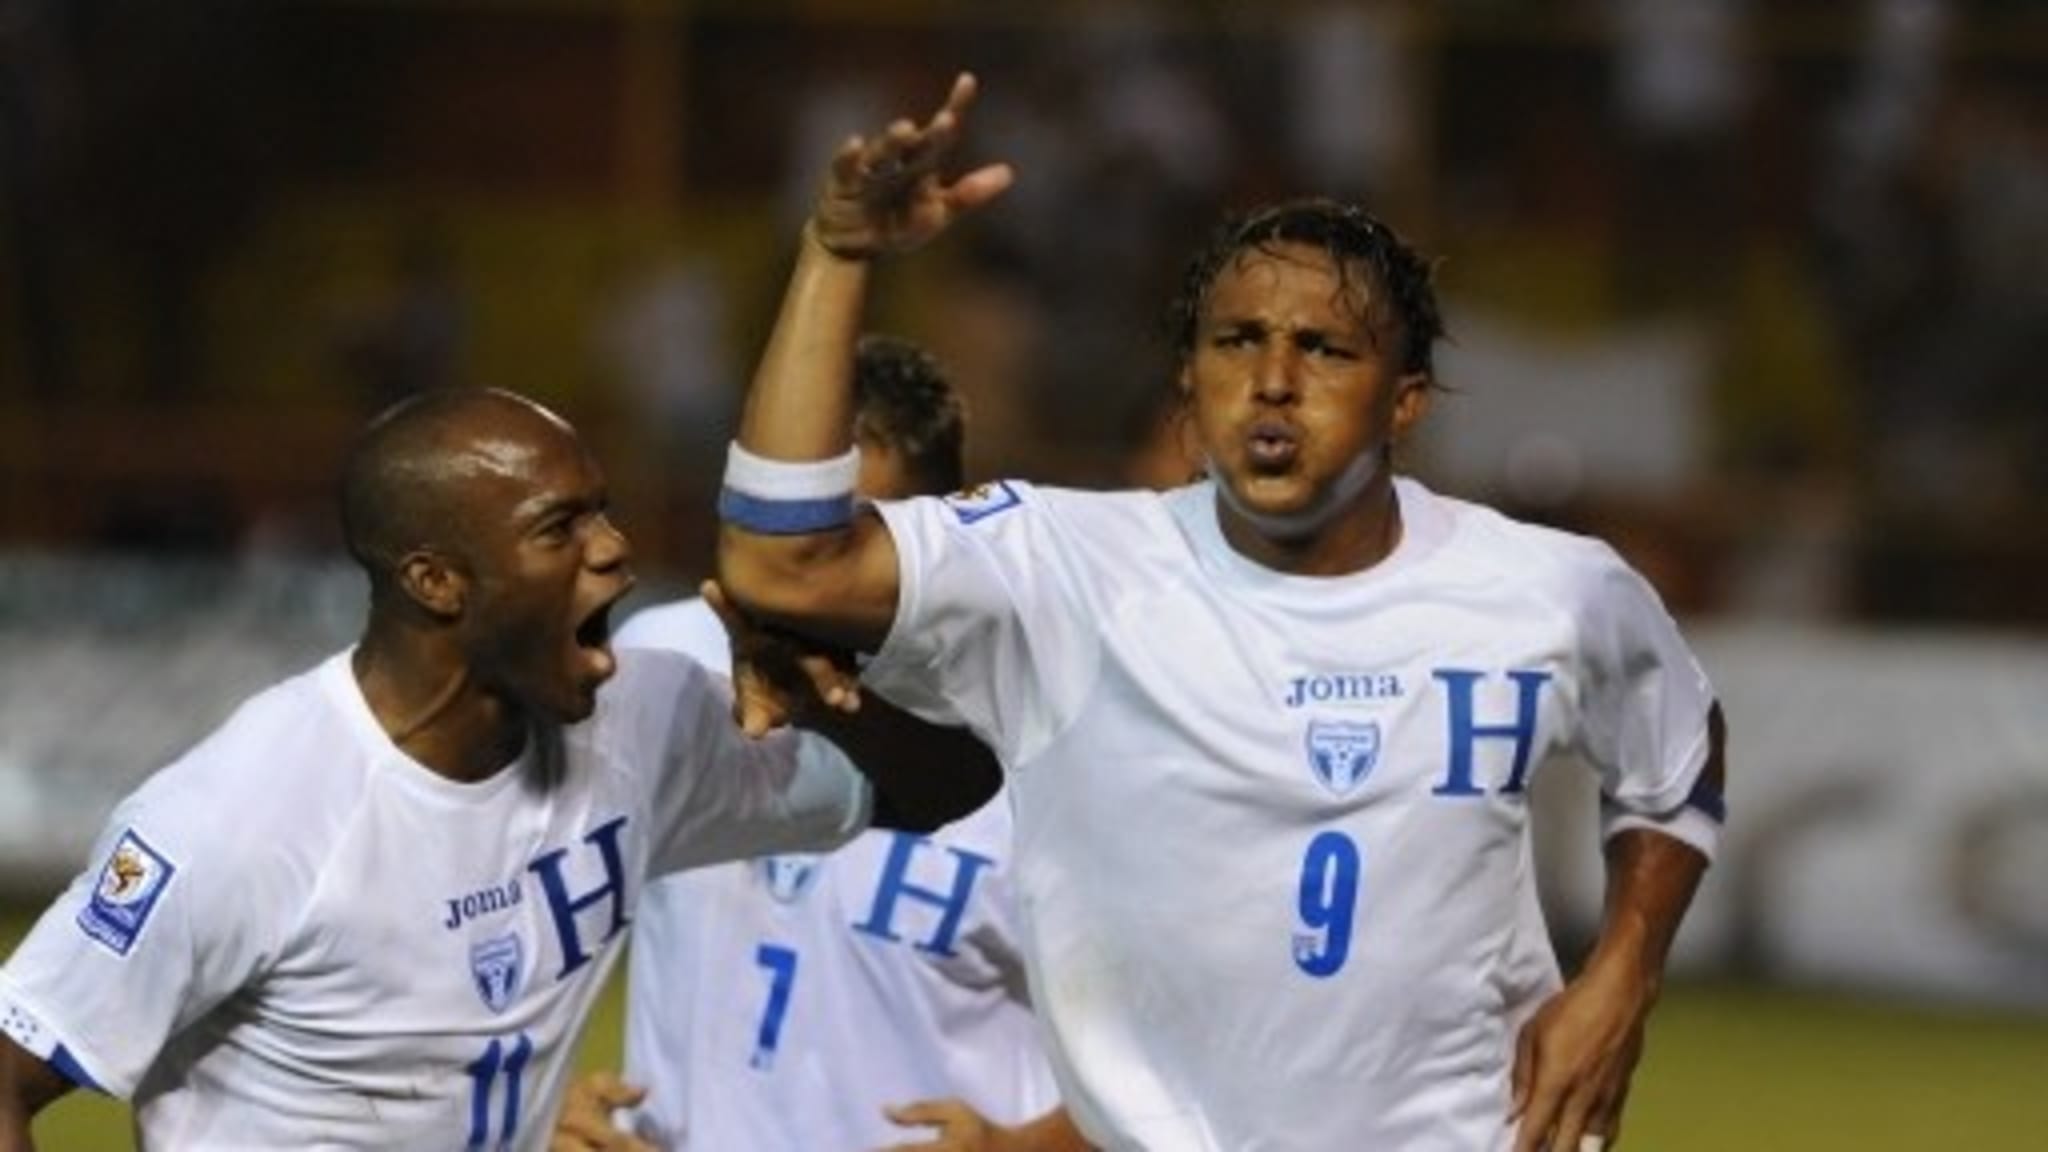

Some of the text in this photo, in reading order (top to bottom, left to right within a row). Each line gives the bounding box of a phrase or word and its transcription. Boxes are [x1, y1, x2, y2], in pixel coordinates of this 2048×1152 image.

[1431, 669, 1553, 796] H
[528, 816, 630, 981] H
[852, 832, 995, 958] H
[1293, 831, 1360, 977] 9
[756, 944, 797, 1056] 7
[467, 1031, 533, 1152] 11
